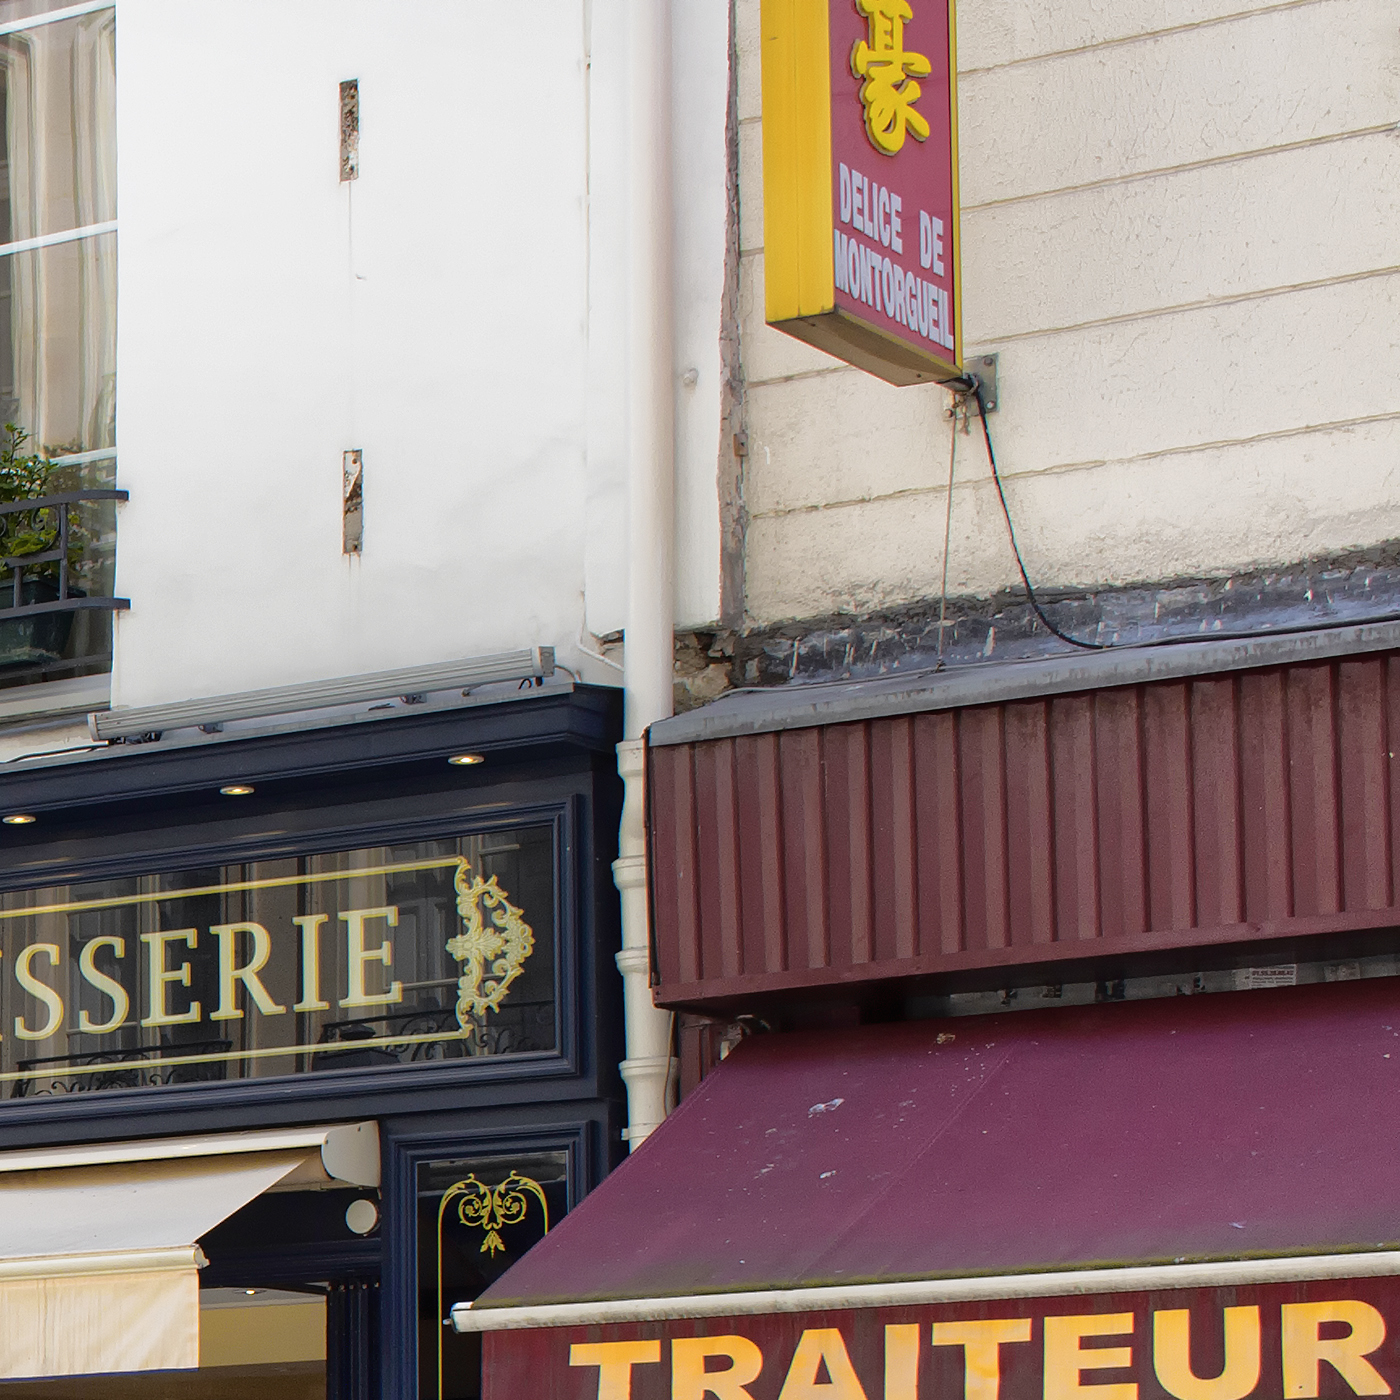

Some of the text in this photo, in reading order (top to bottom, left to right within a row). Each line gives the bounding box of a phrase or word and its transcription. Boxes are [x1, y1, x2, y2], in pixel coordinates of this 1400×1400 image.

[839, 162, 944, 277] DELICE DE
[834, 228, 954, 350] MONTORGUEIL
